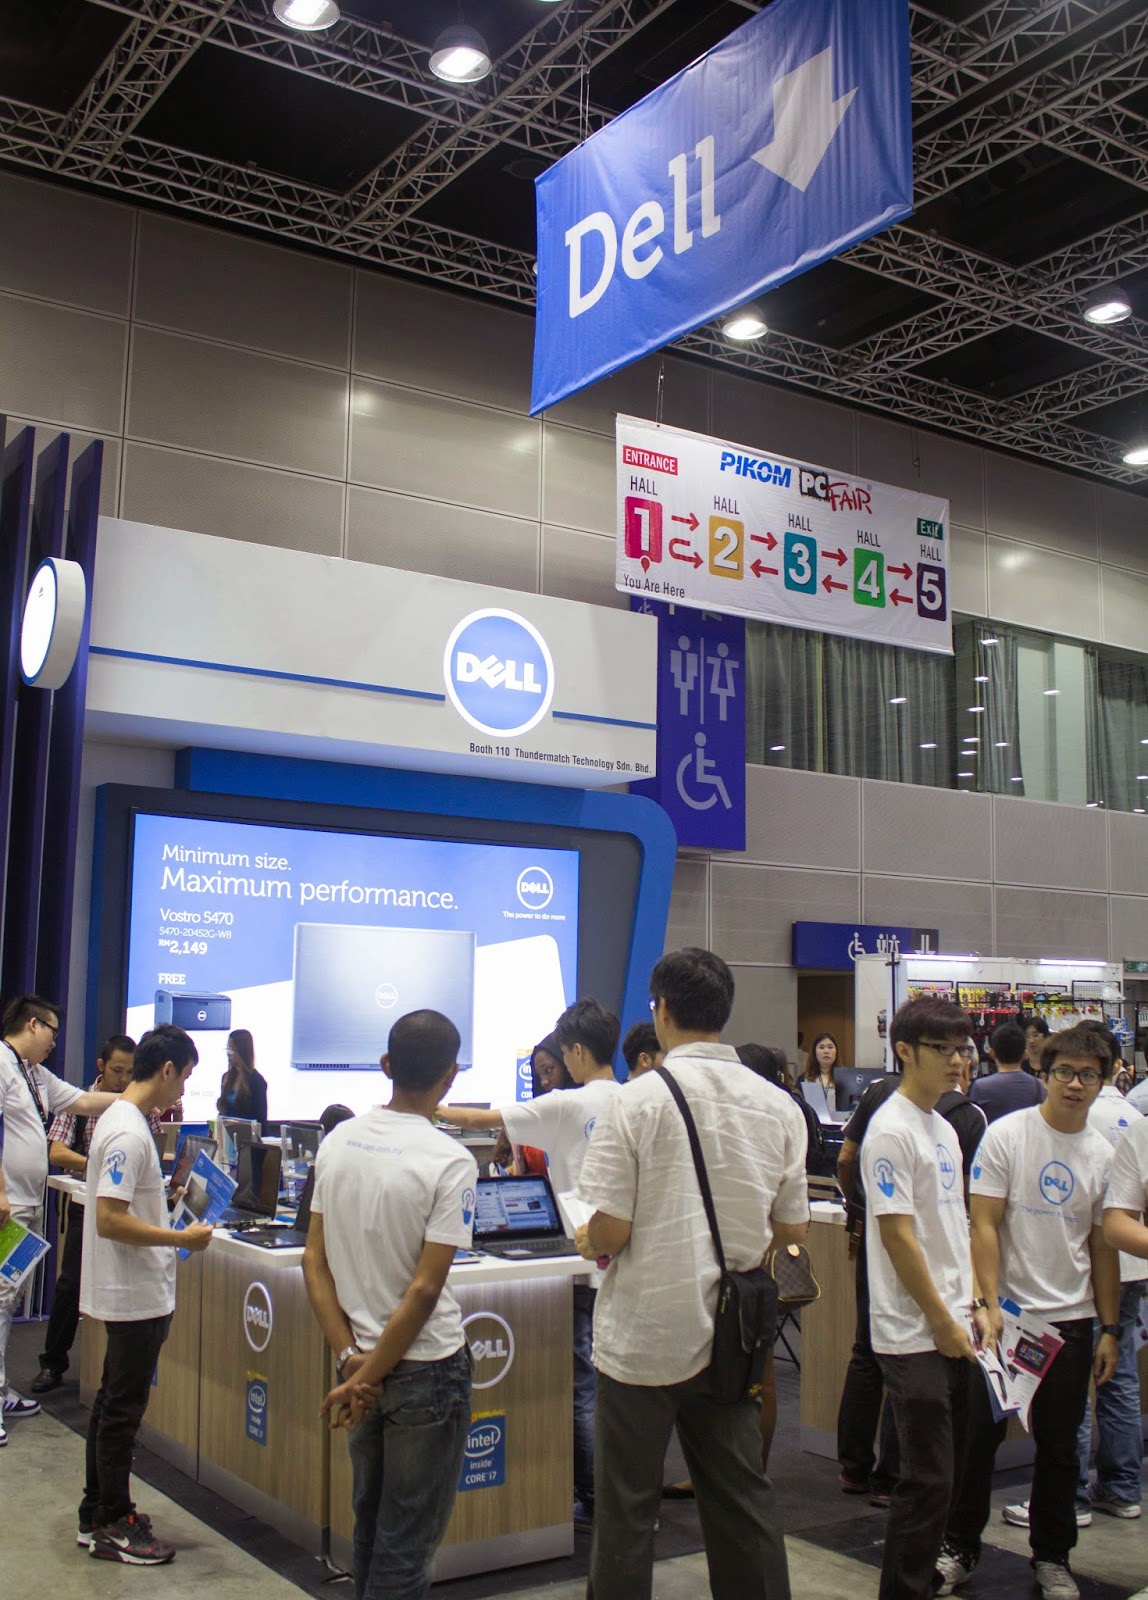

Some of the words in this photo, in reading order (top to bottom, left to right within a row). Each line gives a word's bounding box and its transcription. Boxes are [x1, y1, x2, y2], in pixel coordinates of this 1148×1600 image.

[565, 135, 721, 319] Dell
[625, 448, 675, 473] ENTRANCE
[630, 475, 658, 496] HALL
[720, 451, 792, 488] PIKOM
[800, 471, 827, 498] PC
[713, 495, 740, 515] HALL
[634, 506, 650, 553] 1
[788, 512, 813, 532] HALL
[920, 522, 939, 538] Exit
[714, 526, 740, 572] 2
[857, 529, 882, 548] HALL
[788, 542, 813, 585] 3
[920, 543, 942, 562] HALL
[623, 573, 641, 590] You
[643, 577, 661, 594] Are
[663, 581, 685, 599] Here
[857, 559, 881, 599] 4
[920, 571, 943, 611] 5
[456, 650, 542, 694] DELL
[469, 742, 493, 755] Booth
[495, 745, 510, 757] 110
[514, 747, 570, 764] Thundermatch
[572, 754, 615, 771] Technology
[616, 760, 633, 772] Sdn.
[635, 762, 652, 774] Bhd.
[161, 843, 250, 868] Minimum
[254, 852, 293, 871] size.
[160, 865, 293, 899] Maximum
[299, 879, 459, 910] performance.
[521, 882, 549, 894] DELL
[159, 907, 202, 923] Vostro
[203, 910, 234, 925] 5470
[502, 910, 514, 919] The
[515, 912, 534, 920] power
[157, 972, 187, 986] FREE
[520, 1091, 534, 1099] COR
[246, 1305, 269, 1329] DELL
[470, 1338, 508, 1361] ELL
[467, 1431, 495, 1449] intel
[470, 1459, 493, 1470] inside
[465, 1472, 487, 1485] CORE
